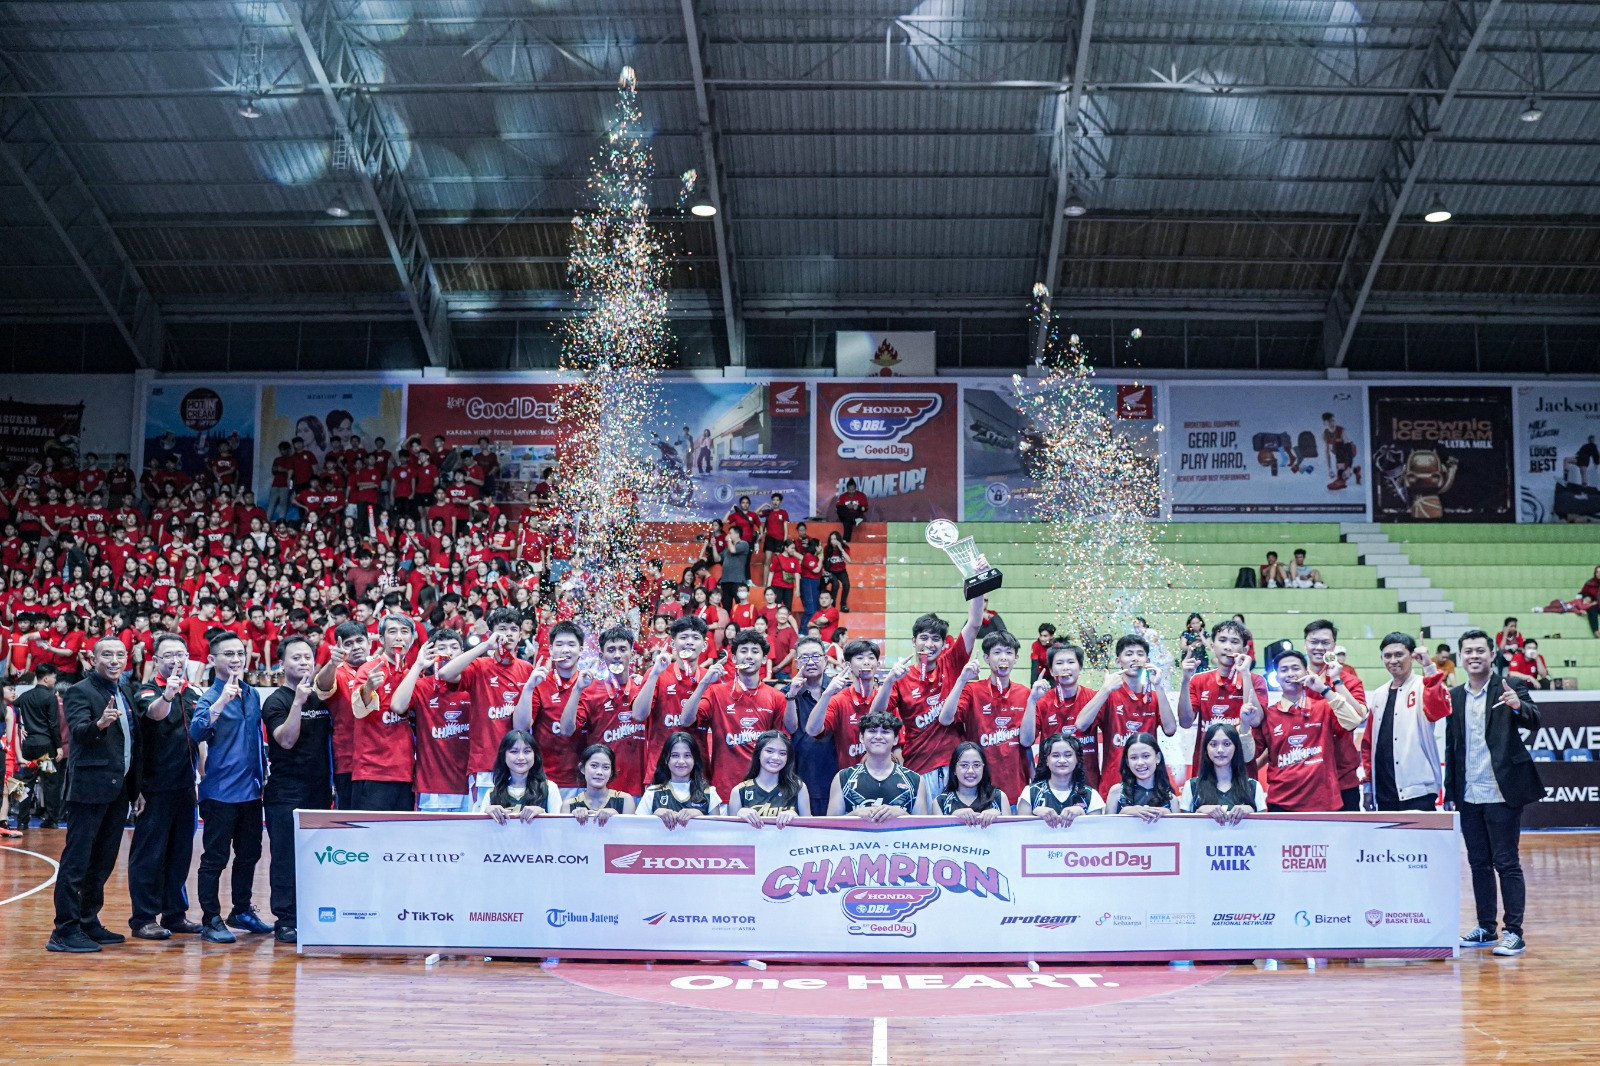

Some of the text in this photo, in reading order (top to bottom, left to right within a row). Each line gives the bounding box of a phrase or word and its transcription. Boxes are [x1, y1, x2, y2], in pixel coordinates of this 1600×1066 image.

[466, 397, 519, 419] Good
[861, 420, 887, 431] DBL
[1188, 431, 1238, 449] GEAR UP,
[1393, 430, 1493, 440] ICE CREAM
[865, 445, 889, 454] Good
[890, 445, 910, 456] Day
[1181, 452, 1246, 470] PLAY HARD,
[1530, 459, 1556, 471] BEST
[900, 468, 927, 493] UP!
[1407, 691, 1416, 707] G
[789, 842, 846, 857] CENTRAL
[849, 841, 880, 850] JAVA
[893, 841, 991, 857] CHAMPIONSHIP
[1206, 845, 1256, 857] ULTRA
[483, 854, 589, 864] AZAWEAR.COM
[1064, 851, 1113, 867] Good
[1115, 850, 1152, 870] Day
[1356, 849, 1428, 863] Jackson
[642, 857, 750, 869] HONDA
[1211, 860, 1251, 871] MILK
[1282, 858, 1327, 869] CREAM
[762, 853, 1011, 902] CHAMPION
[867, 905, 891, 914] DBL
[412, 912, 454, 922] TikTok
[469, 912, 525, 922] MAINBASKET
[546, 908, 619, 928] Tribun Jateng
[669, 915, 756, 924] ASTRA MOTOR
[1000, 915, 1078, 925] proteam
[1213, 913, 1276, 921] DISWAY.ID
[1315, 914, 1352, 923] Biznet
[870, 924, 912, 933] Good Day
[670, 973, 1121, 990] One HEART.
